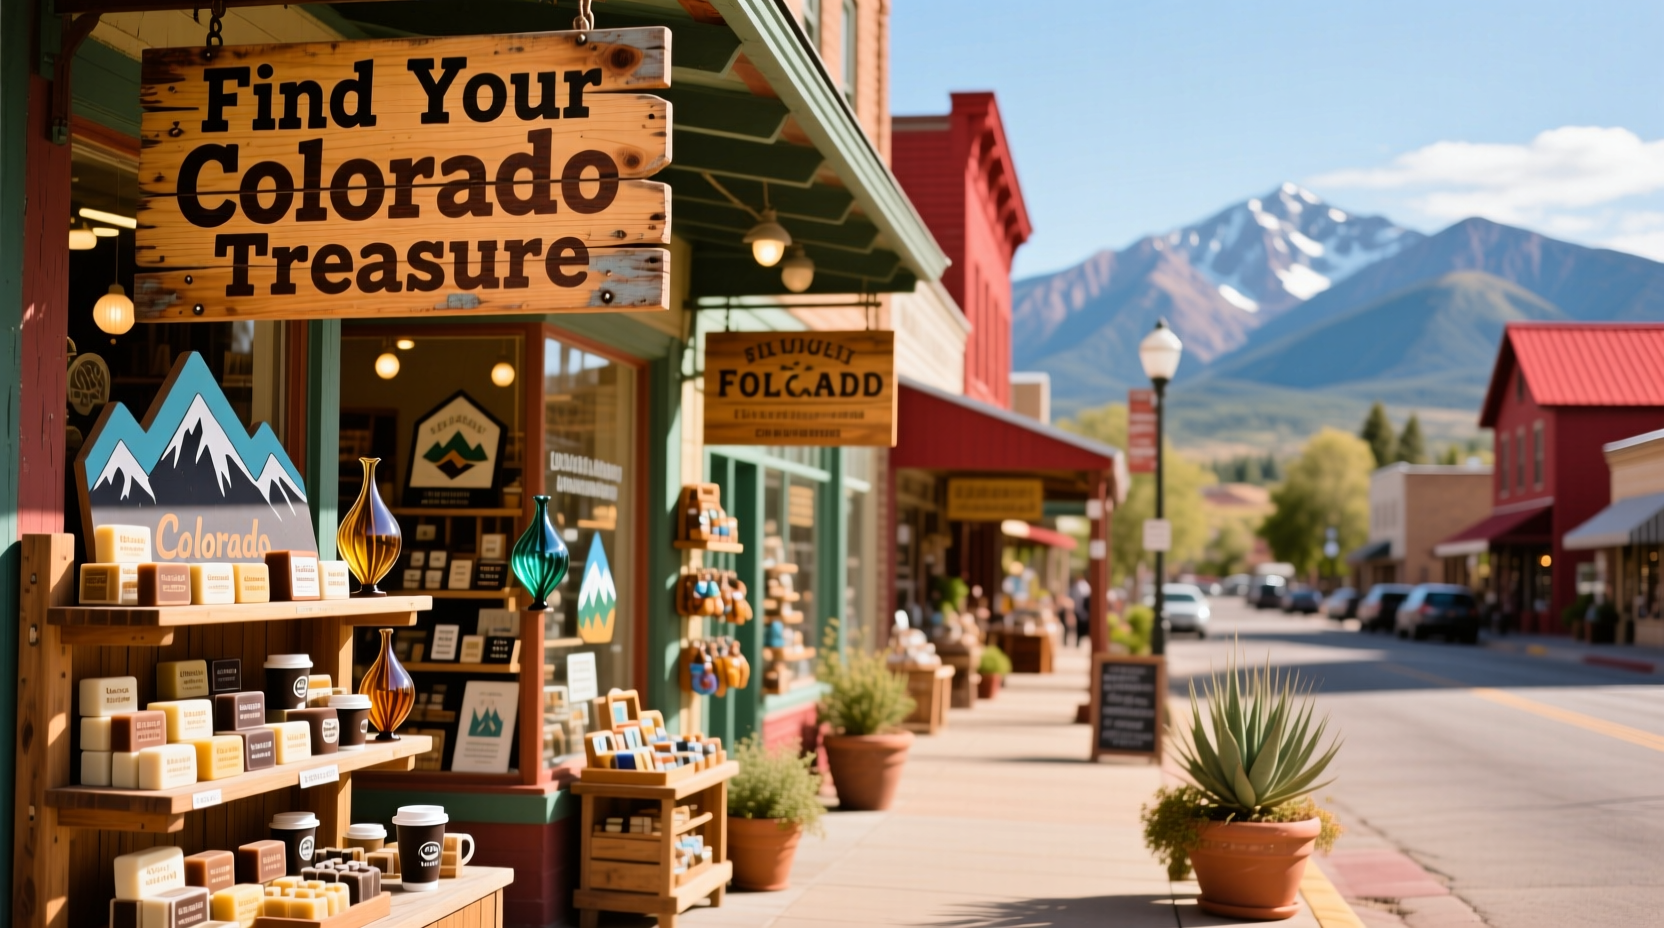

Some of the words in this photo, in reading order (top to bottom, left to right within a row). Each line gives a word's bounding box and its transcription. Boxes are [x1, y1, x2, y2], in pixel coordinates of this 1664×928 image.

[201, 59, 377, 132] Find
[407, 56, 602, 124] Your
[176, 128, 619, 228] Colorado
[214, 232, 590, 297] Treasure
[156, 513, 271, 559] Colorado
